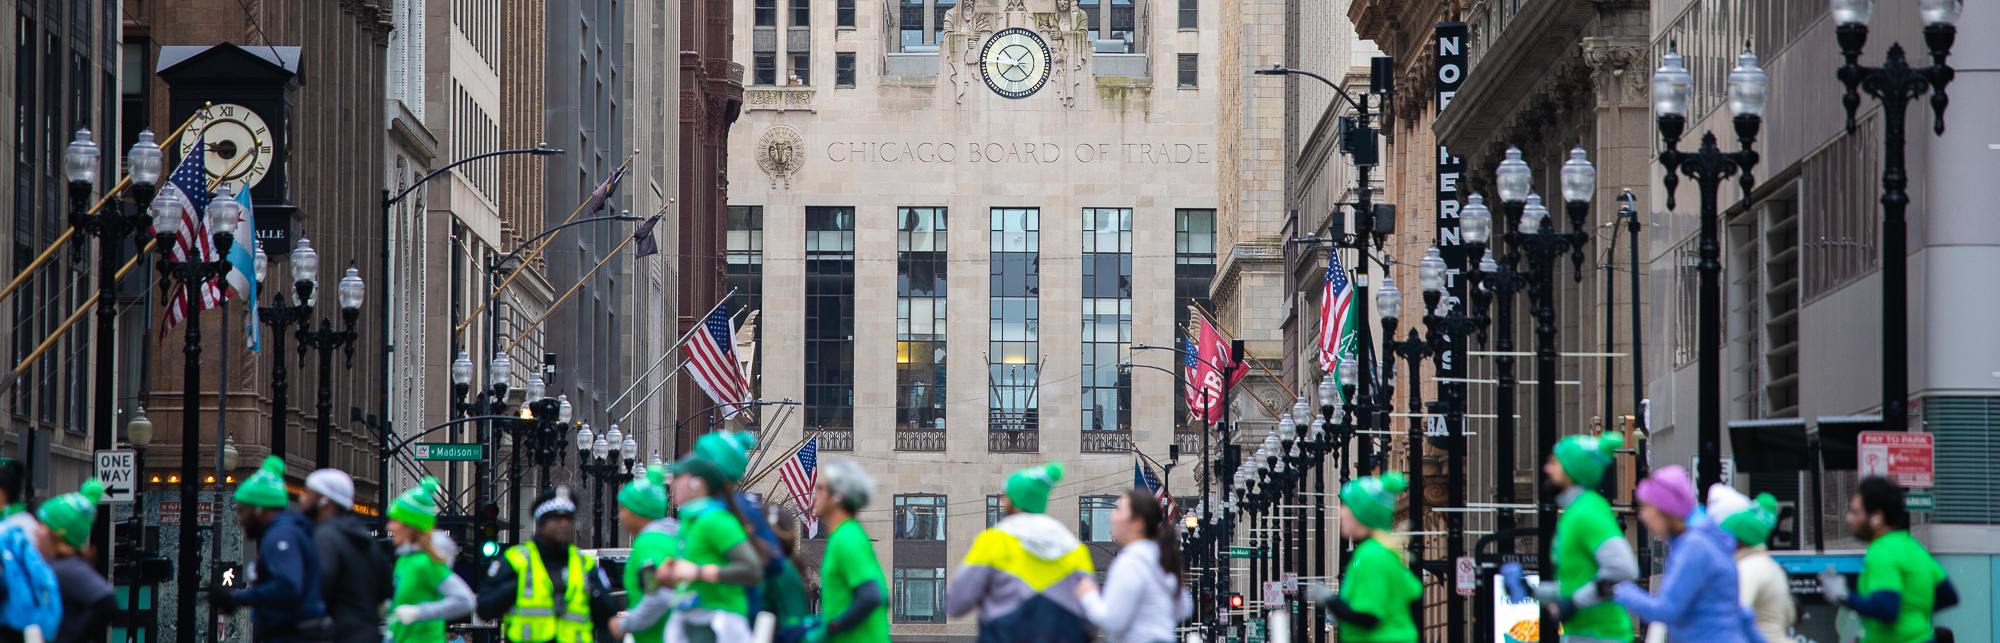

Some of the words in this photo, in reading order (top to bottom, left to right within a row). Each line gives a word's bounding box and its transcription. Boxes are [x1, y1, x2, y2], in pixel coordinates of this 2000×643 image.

[219, 106, 234, 117] XII
[1439, 36, 1461, 246] NOHERN
[827, 141, 957, 163] CHICAGO
[969, 142, 1060, 164] BOARD
[1074, 143, 1110, 163] OF
[1121, 143, 1209, 165] TRADE
[254, 229, 285, 239] ALLE
[1196, 355, 1224, 409] CIBC
[1886, 435, 1900, 443] TO
[436, 446, 472, 457] Madison
[101, 455, 131, 468] ONE
[100, 469, 131, 482] WAY
[1905, 497, 1932, 507] ARKING
